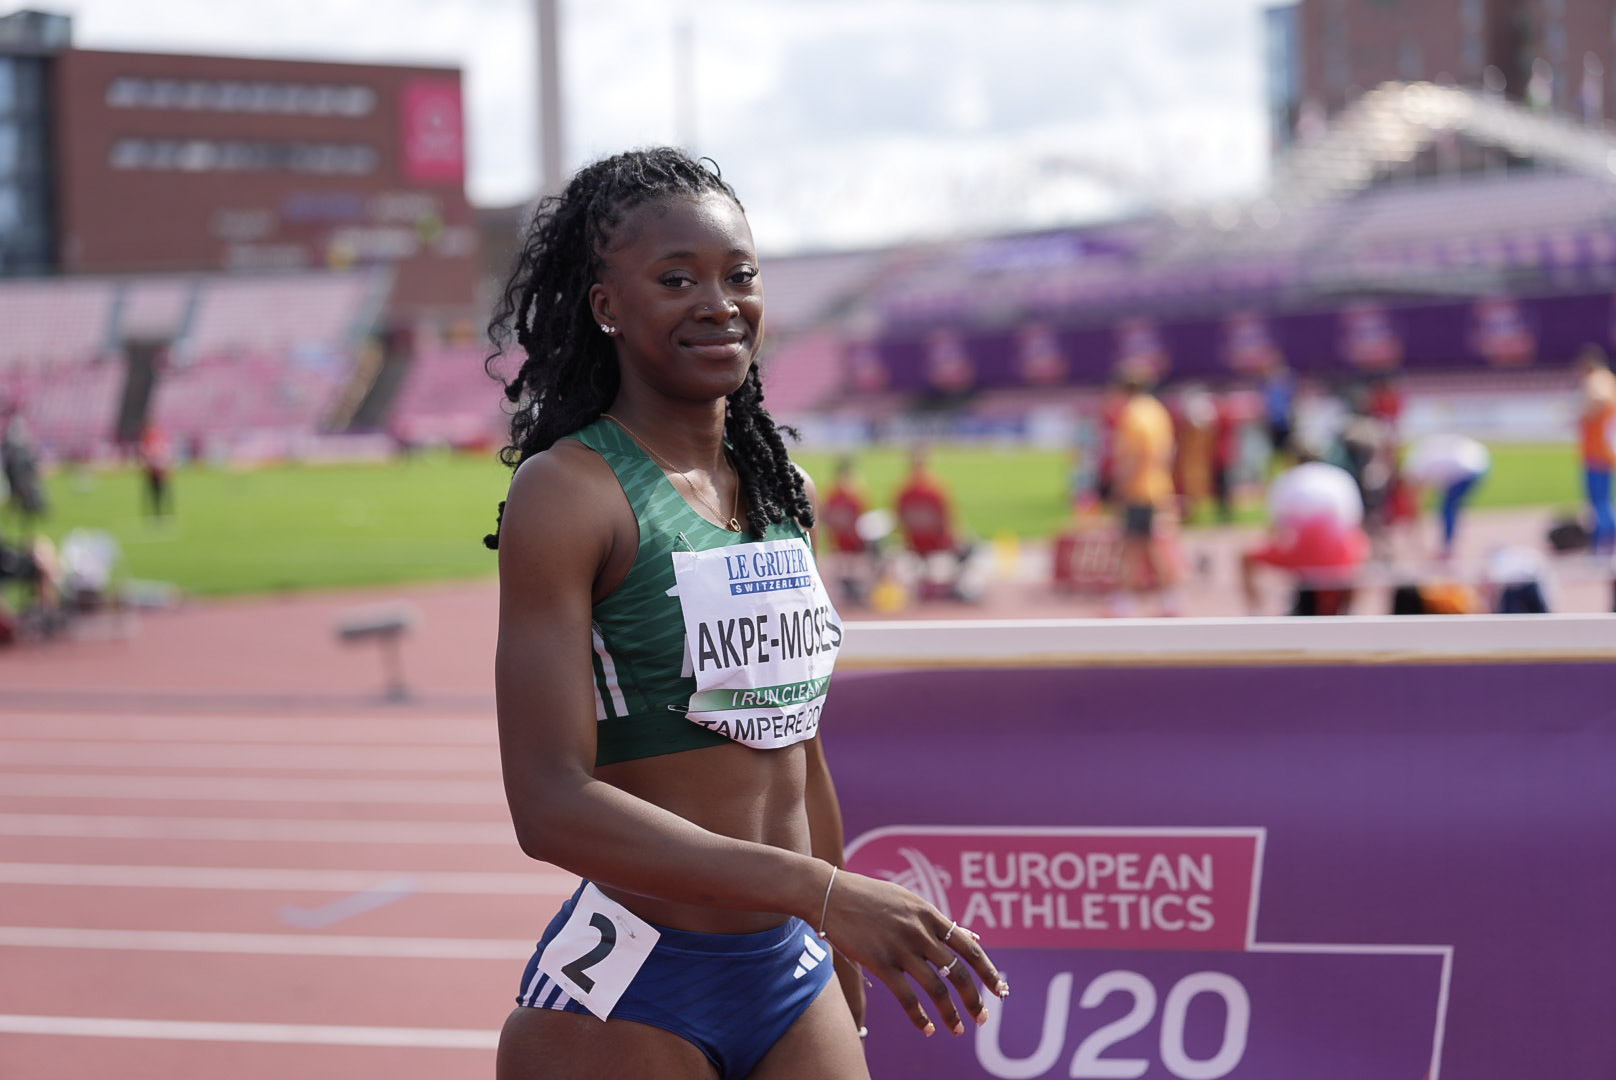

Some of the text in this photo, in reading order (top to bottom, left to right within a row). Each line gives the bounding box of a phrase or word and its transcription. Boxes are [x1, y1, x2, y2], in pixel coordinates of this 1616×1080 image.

[724, 555, 750, 580] LE
[735, 575, 810, 593] SWITZERLAND
[699, 604, 842, 671] AKPE-MOSES
[731, 679, 824, 706] I RUN CLEAN
[699, 706, 820, 740] TAMPERE 20
[960, 851, 1213, 890] EUROPEAN
[961, 892, 1215, 931] ATHLETICS
[561, 912, 617, 994] 2
[974, 969, 1250, 1080] U20
